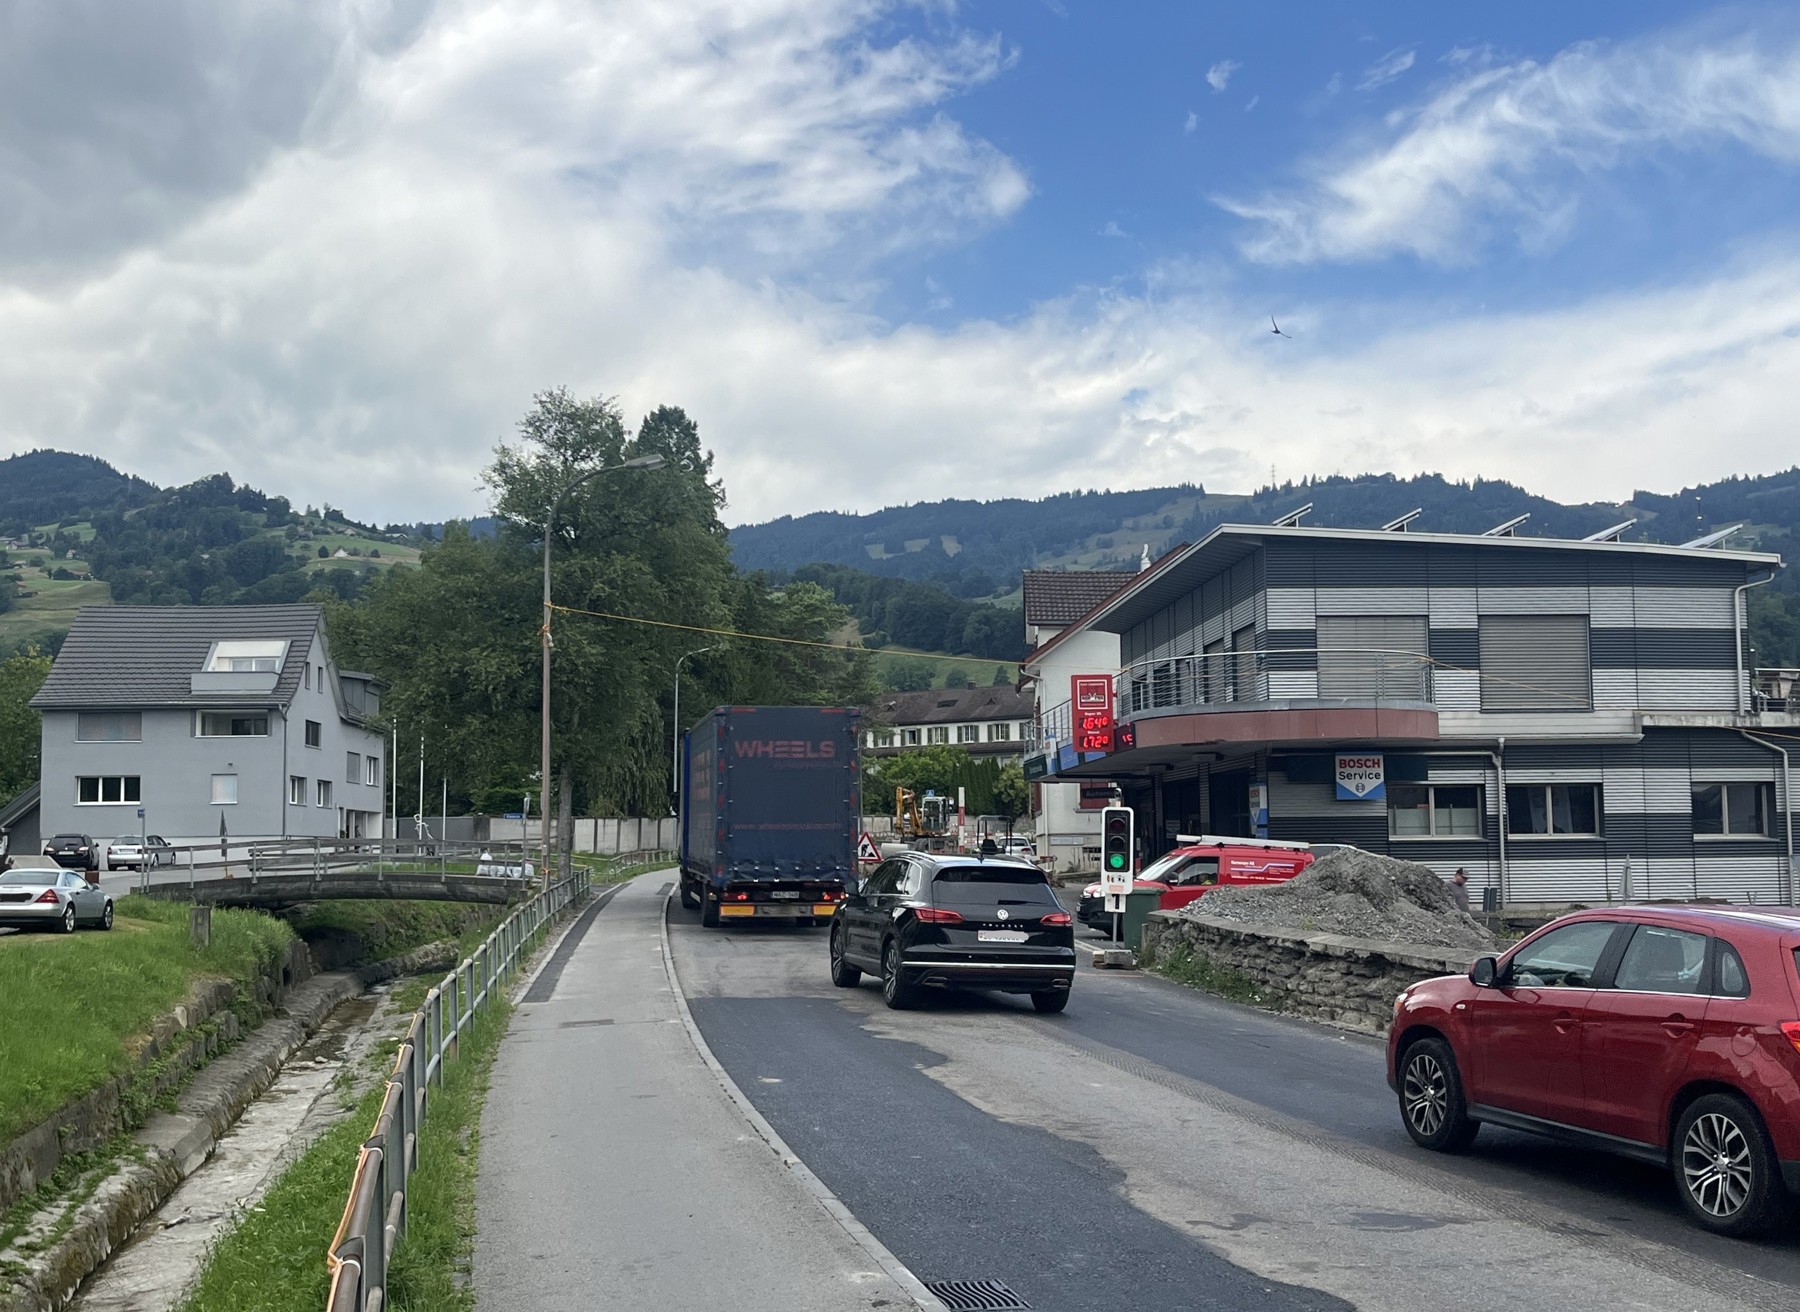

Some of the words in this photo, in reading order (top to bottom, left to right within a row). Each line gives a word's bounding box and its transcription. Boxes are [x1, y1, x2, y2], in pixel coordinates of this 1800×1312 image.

[735, 740, 834, 758] WHEELS
[1338, 758, 1381, 769] BOSCH
[1338, 770, 1381, 780] Service
